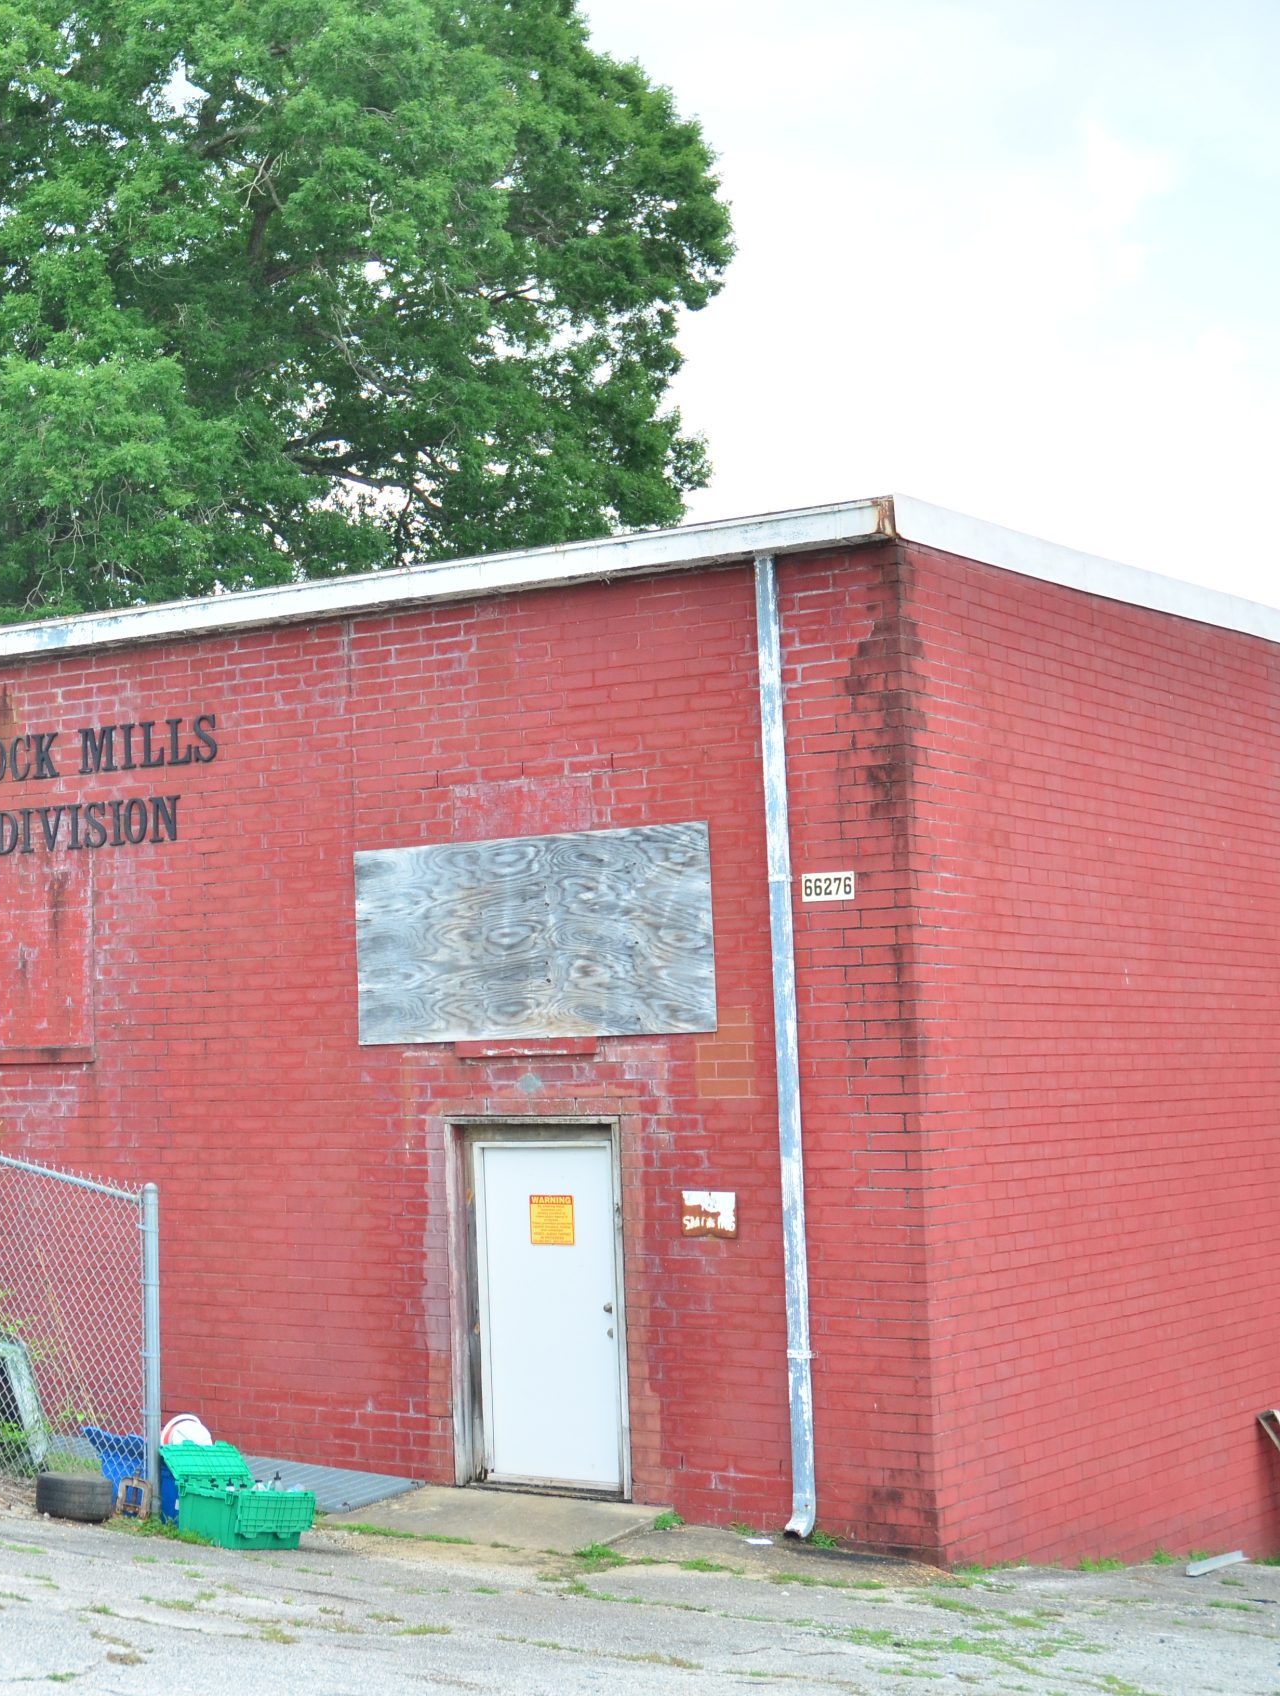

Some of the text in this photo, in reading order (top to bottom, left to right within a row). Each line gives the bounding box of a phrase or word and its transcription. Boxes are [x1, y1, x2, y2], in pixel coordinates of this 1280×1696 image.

[78, 714, 219, 775] MILLS
[804, 877, 852, 897] 66276
[531, 1196, 571, 1204] WARNING
